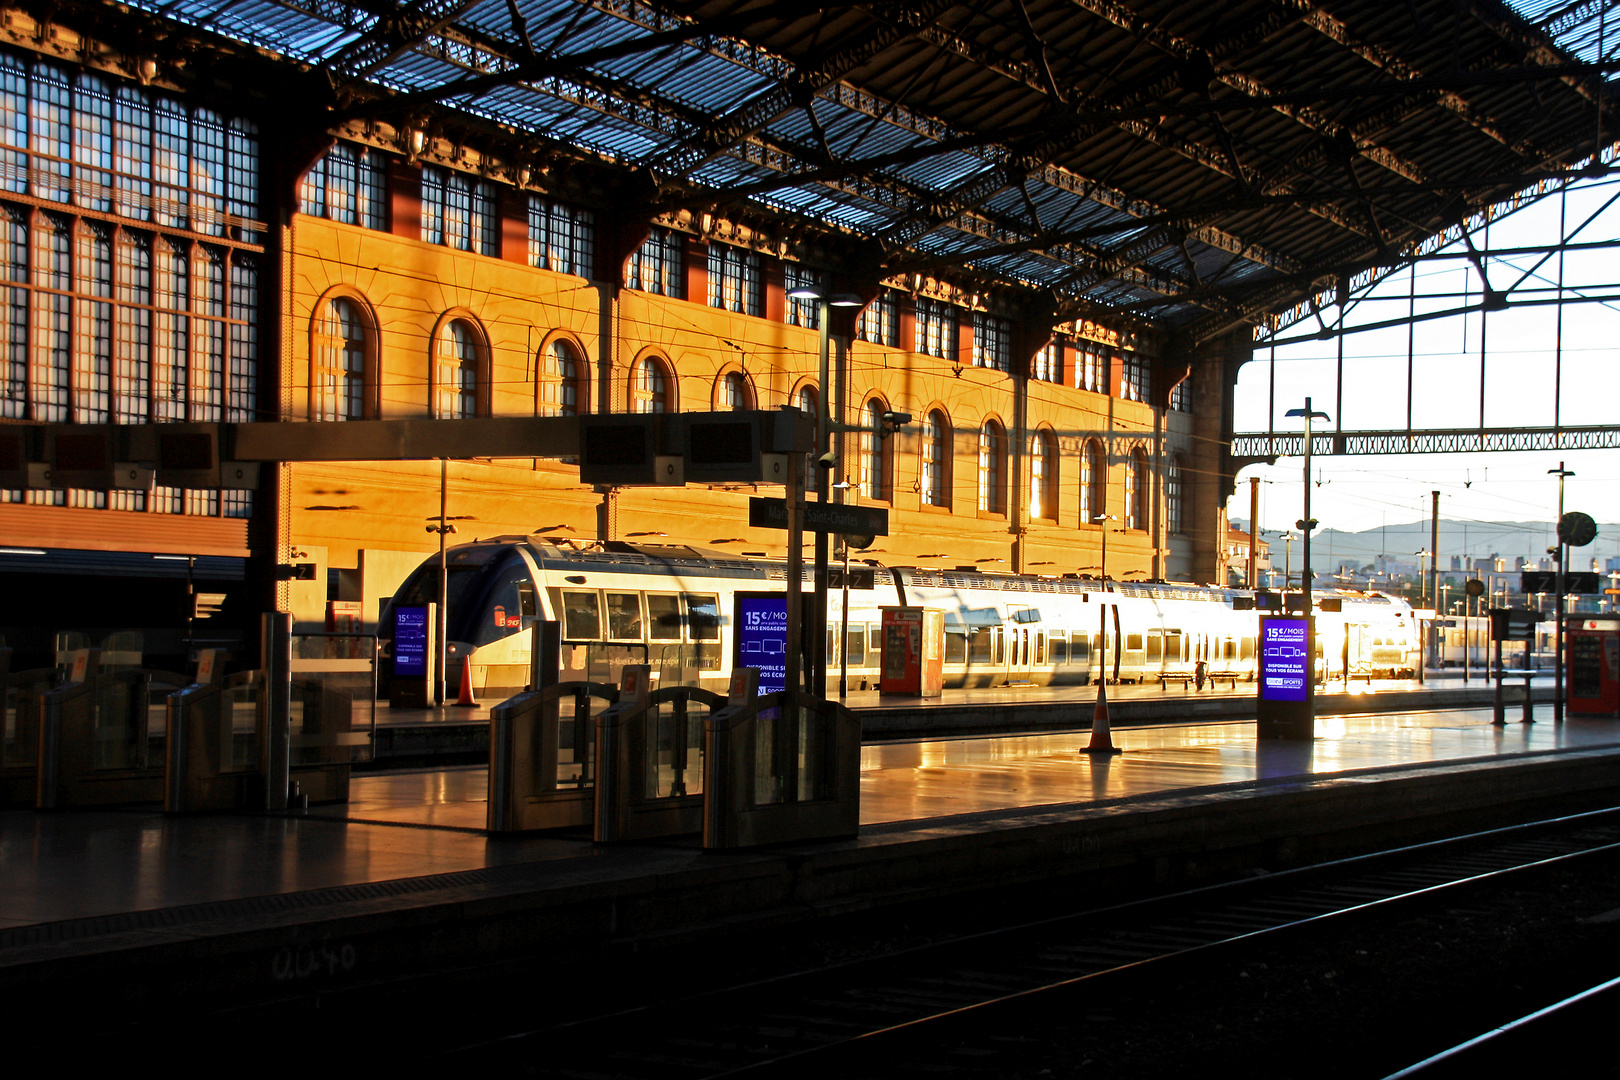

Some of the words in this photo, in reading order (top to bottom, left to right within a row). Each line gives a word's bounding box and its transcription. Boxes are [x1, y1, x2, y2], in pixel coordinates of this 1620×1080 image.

[808, 509, 858, 526] Saint-Charles
[299, 567, 306, 579] Z
[830, 574, 839, 588] Z
[853, 574, 862, 588] Z
[1538, 576, 1549, 592] Z
[1570, 576, 1581, 592] Z
[746, 611, 787, 625] 15€/MO
